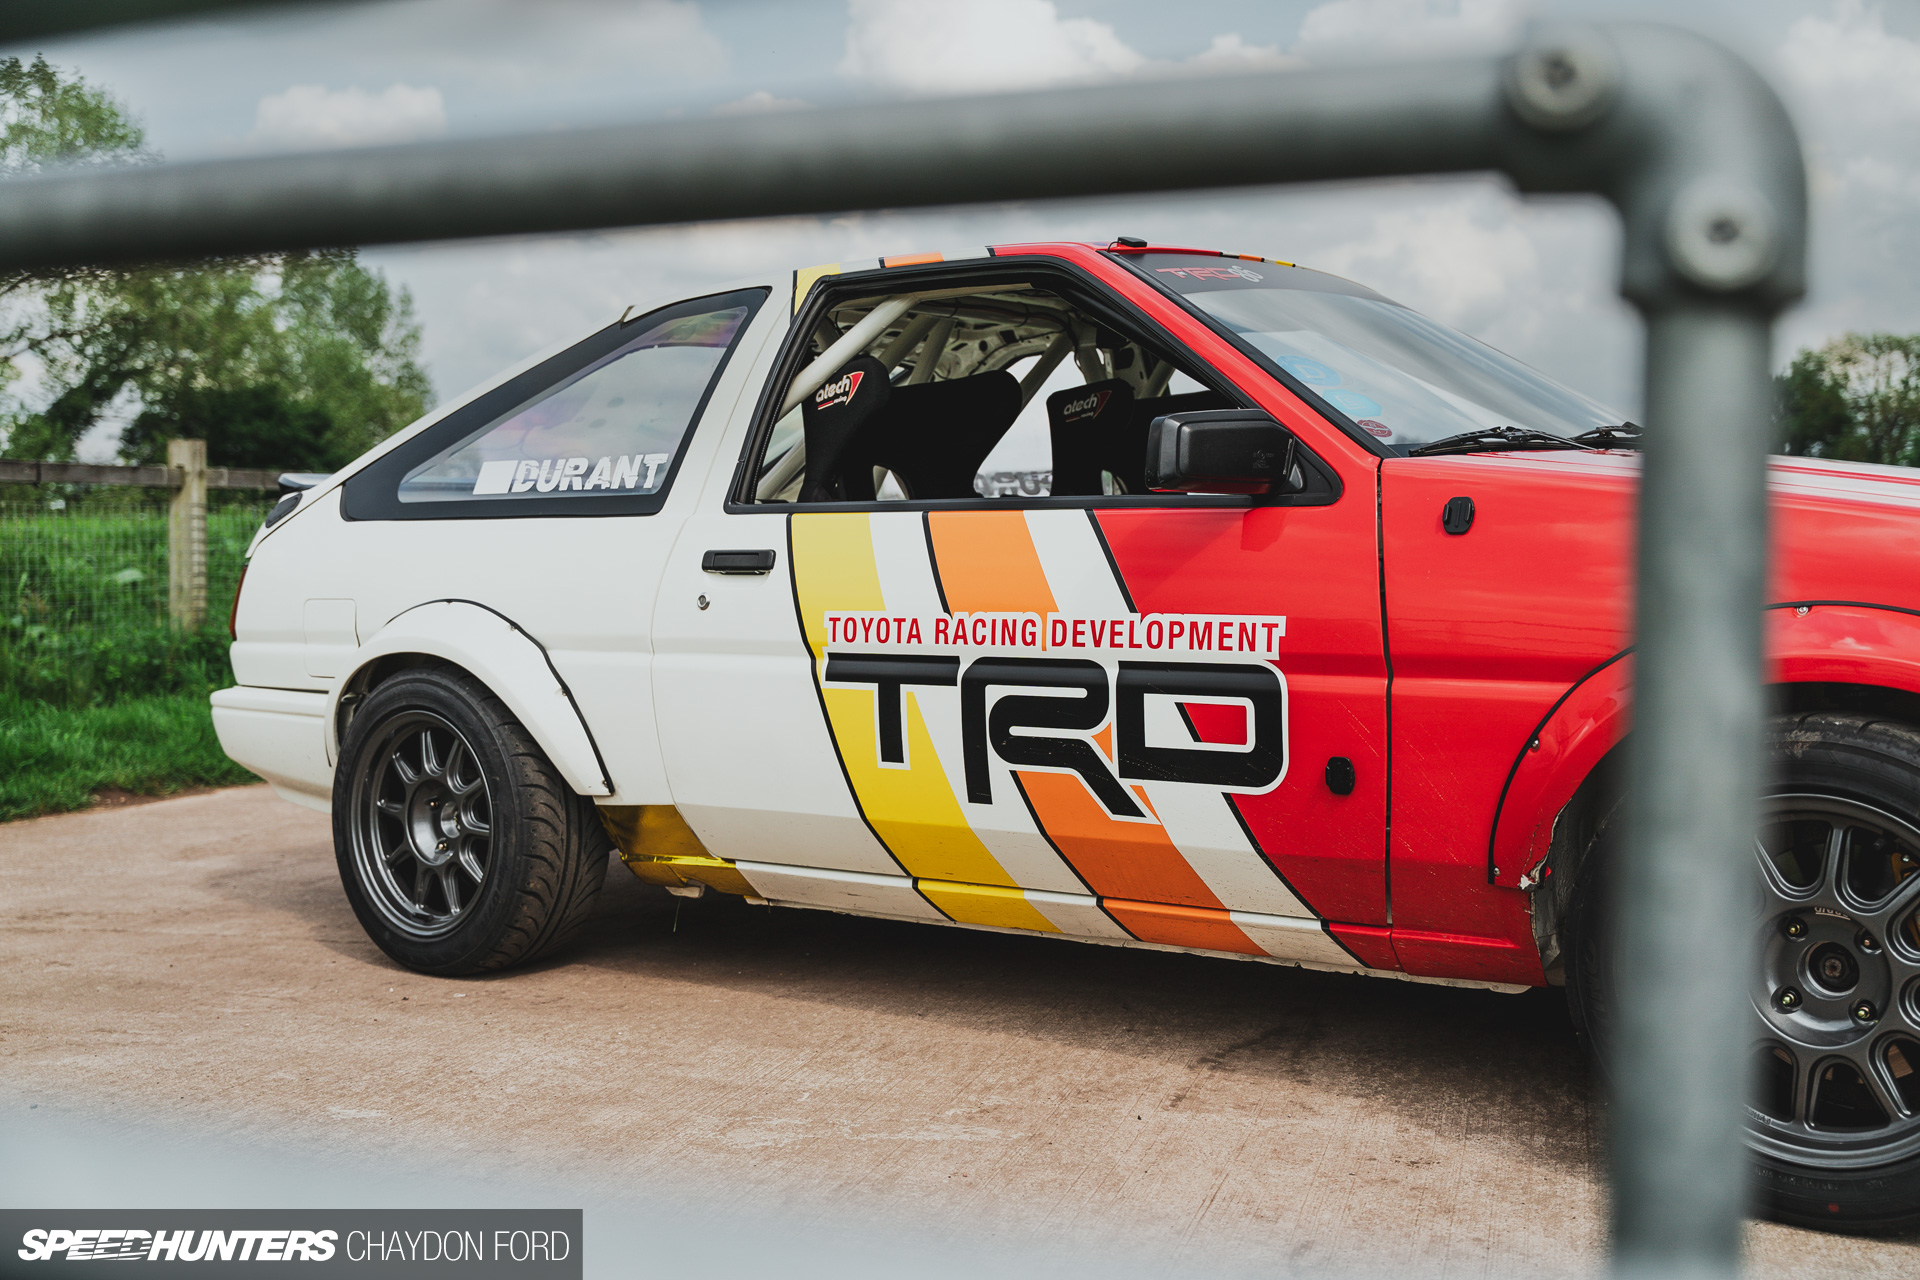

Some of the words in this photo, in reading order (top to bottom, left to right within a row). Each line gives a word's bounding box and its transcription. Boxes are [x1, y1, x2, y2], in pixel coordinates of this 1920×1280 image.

[1155, 267, 1241, 281] TRD
[815, 375, 851, 403] atech
[1063, 393, 1098, 416] atech
[511, 453, 669, 493] DURANT
[828, 616, 923, 645] TOYOTA
[934, 617, 1038, 647] RACING
[1050, 618, 1280, 653] DEVELOPMENT
[825, 652, 1284, 818] TRD
